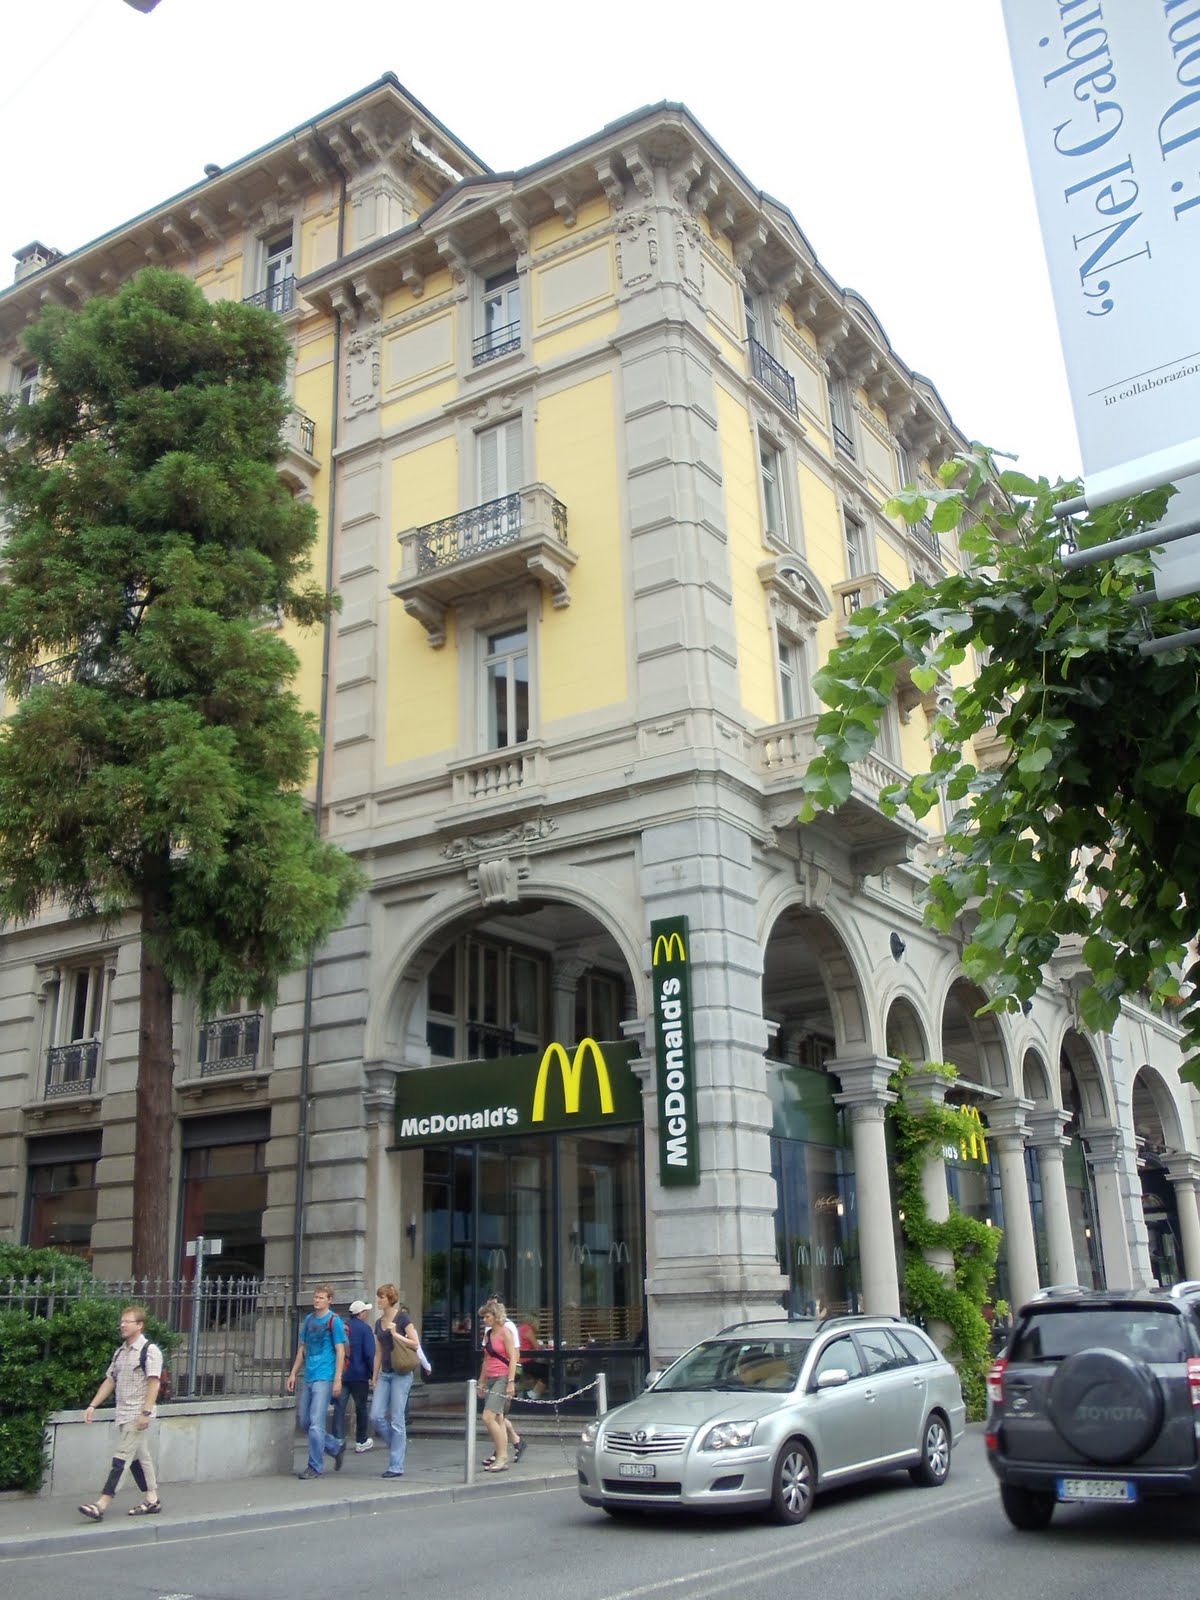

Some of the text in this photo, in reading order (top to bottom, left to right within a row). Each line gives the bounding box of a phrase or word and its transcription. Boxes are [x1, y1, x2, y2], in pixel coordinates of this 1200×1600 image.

[1104, 395, 1117, 406] in
[661, 976, 688, 1167] McDonald's
[400, 1106, 519, 1137] McDonald's
[1075, 1405, 1147, 1422] TOYOTA
